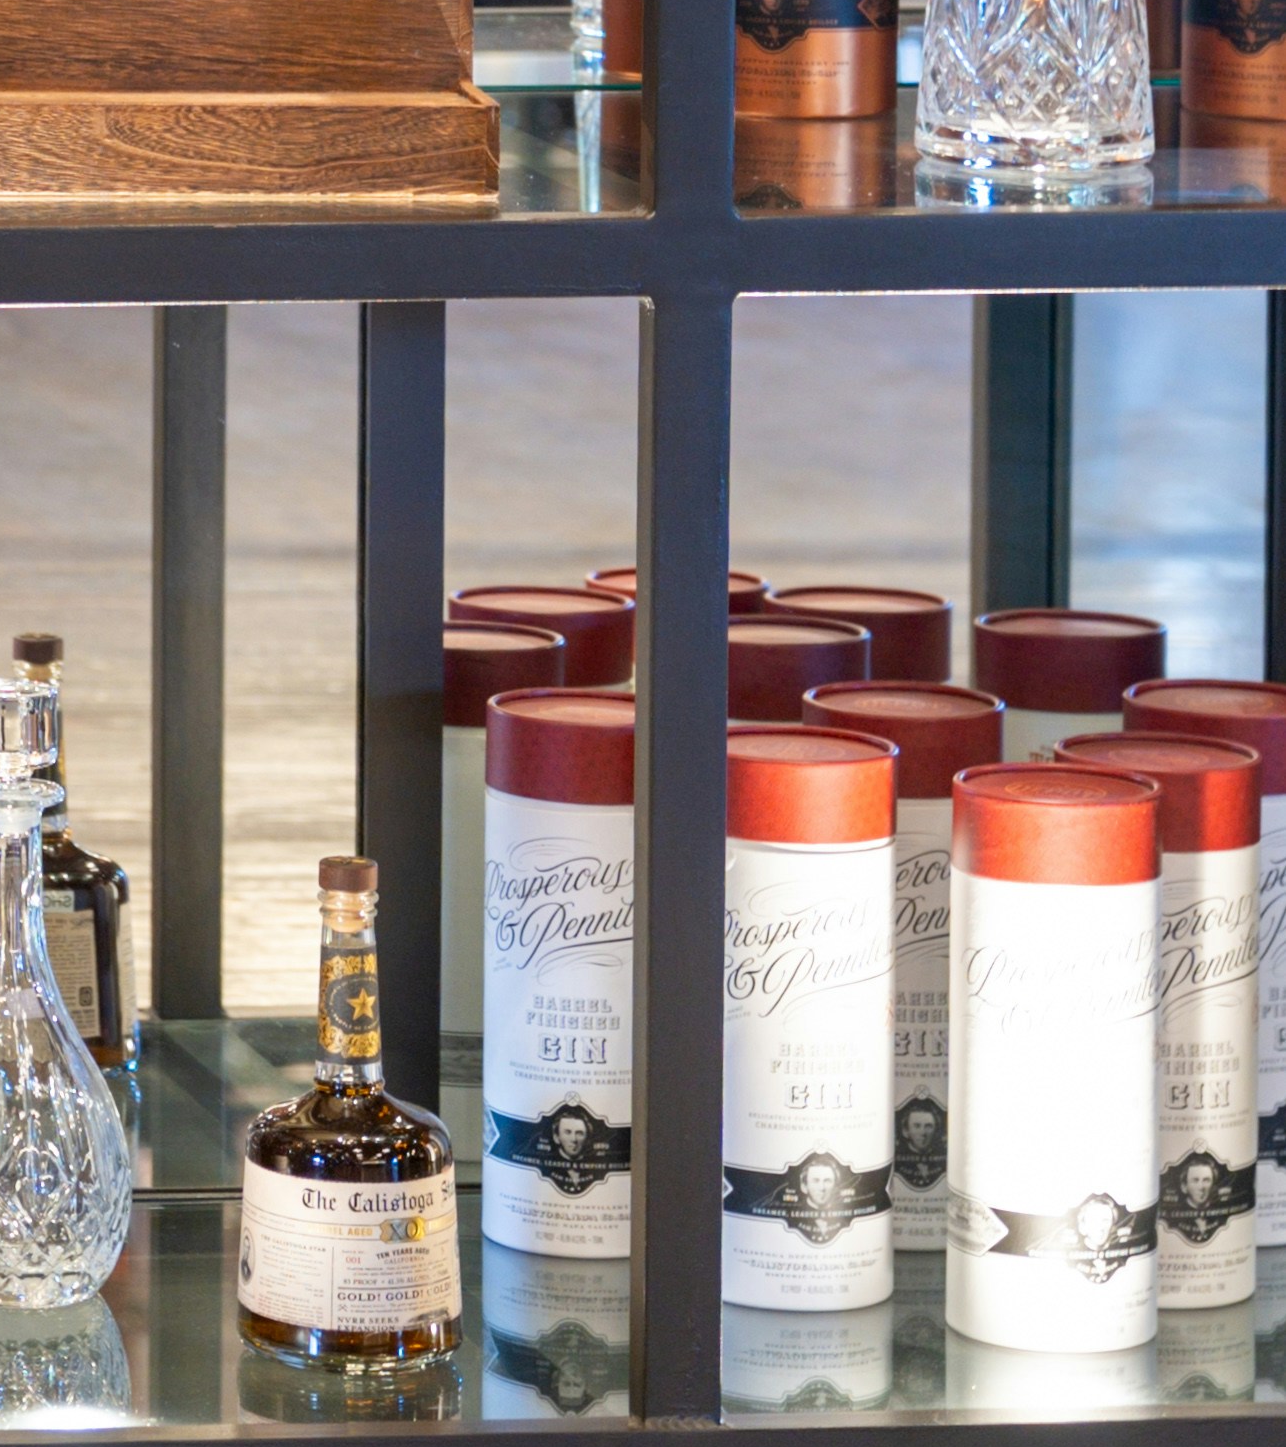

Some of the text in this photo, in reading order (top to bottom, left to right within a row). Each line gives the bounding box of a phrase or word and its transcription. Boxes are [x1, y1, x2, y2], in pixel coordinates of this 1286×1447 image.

[485, 857, 634, 911] Prosperous
[495, 910, 521, 951] &
[727, 956, 766, 1000] &
[533, 994, 612, 1013] BARREL
[526, 1011, 621, 1030] FINISHED
[538, 1033, 608, 1064] GIN
[514, 1069, 591, 1085] CHARDONNAY WINE
[1165, 1079, 1231, 1110] GIN
[544, 1159, 572, 1169] LEADER
[302, 1187, 434, 1214] The Calistoga
[791, 1210, 818, 1218] LEADER
[347, 1221, 420, 1240] AGED XO
[345, 1256, 425, 1265] 001 CALIFORNIA
[376, 1248, 413, 1260] TEN YEARS
[337, 1290, 424, 1302] GOLD! GOLD!
[368, 1316, 400, 1324] SEEKS
